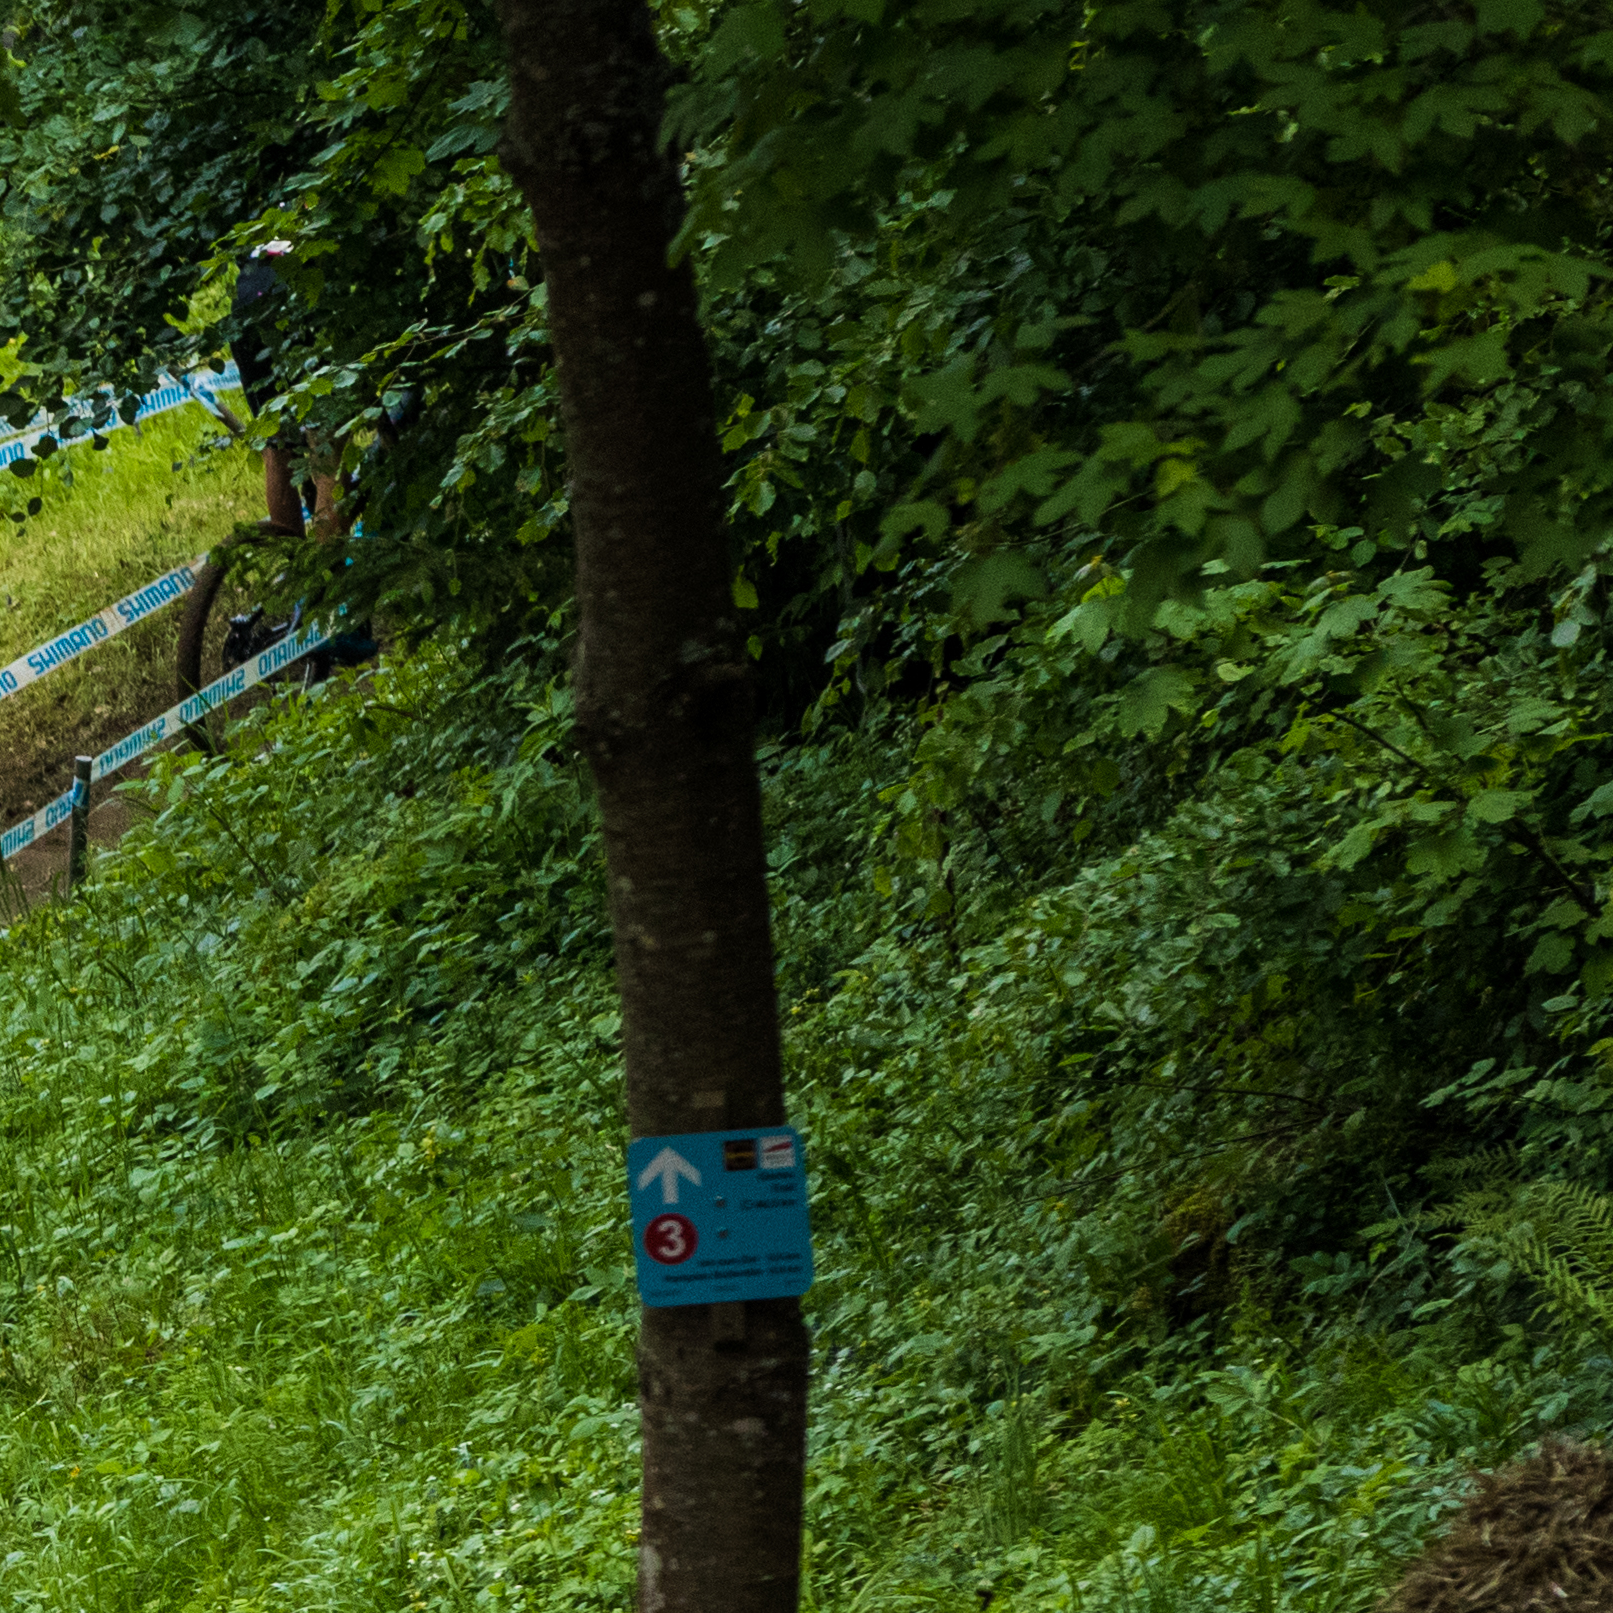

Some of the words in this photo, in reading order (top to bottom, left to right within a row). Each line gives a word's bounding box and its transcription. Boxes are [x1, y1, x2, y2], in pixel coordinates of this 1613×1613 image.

[28, 617, 109, 676] SHIMANO
[117, 565, 197, 624] SHIMANO
[656, 1220, 688, 1257] 3
